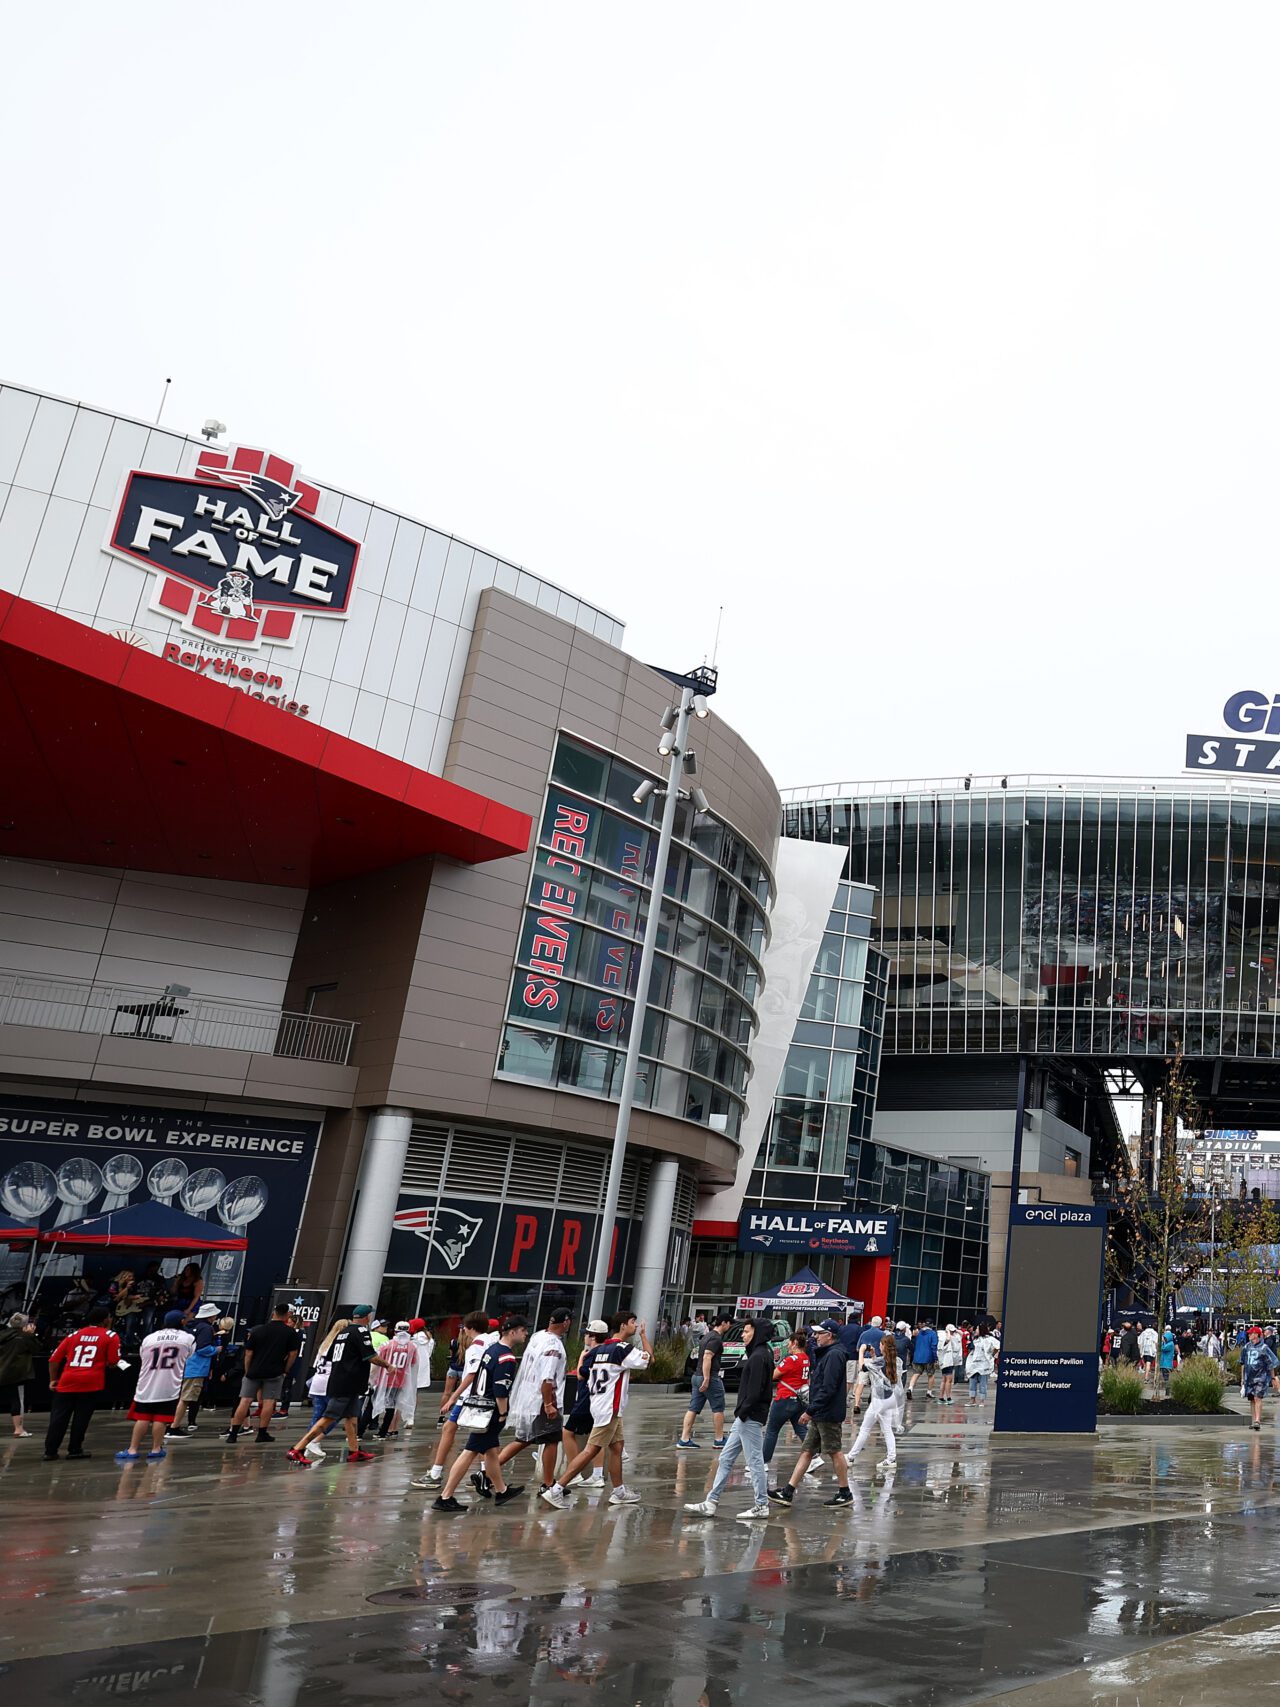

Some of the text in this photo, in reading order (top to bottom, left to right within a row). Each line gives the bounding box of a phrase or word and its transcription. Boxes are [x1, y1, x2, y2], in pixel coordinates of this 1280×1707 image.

[193, 494, 301, 546] HALL
[235, 527, 259, 542] OF
[129, 505, 339, 602] FAME
[181, 639, 253, 664] PRESENTED BY
[162, 642, 284, 689] Raytheon
[120, 1114, 204, 1128] VISIT THE
[0, 1117, 305, 1155] SUPER BOWL EXPERIENCE
[1196, 1141, 1262, 1151] STADIUM
[750, 1214, 888, 1235] HALL OF FAME
[1025, 1208, 1092, 1223] enel plaza
[1112, 1336, 1122, 1348] 12
[69, 1345, 98, 1367] 12
[149, 1346, 180, 1370] 12
[332, 1342, 345, 1362] 88
[392, 1351, 408, 1369] 10
[1010, 1357, 1028, 1365] Cross
[1028, 1357, 1059, 1365] Insurance
[1246, 1350, 1259, 1365] 12
[591, 1368, 609, 1396] 12
[802, 1366, 810, 1380] 12
[1009, 1369, 1049, 1377] Patriot Place
[1008, 1381, 1072, 1389] Restrooms/ Elevator
